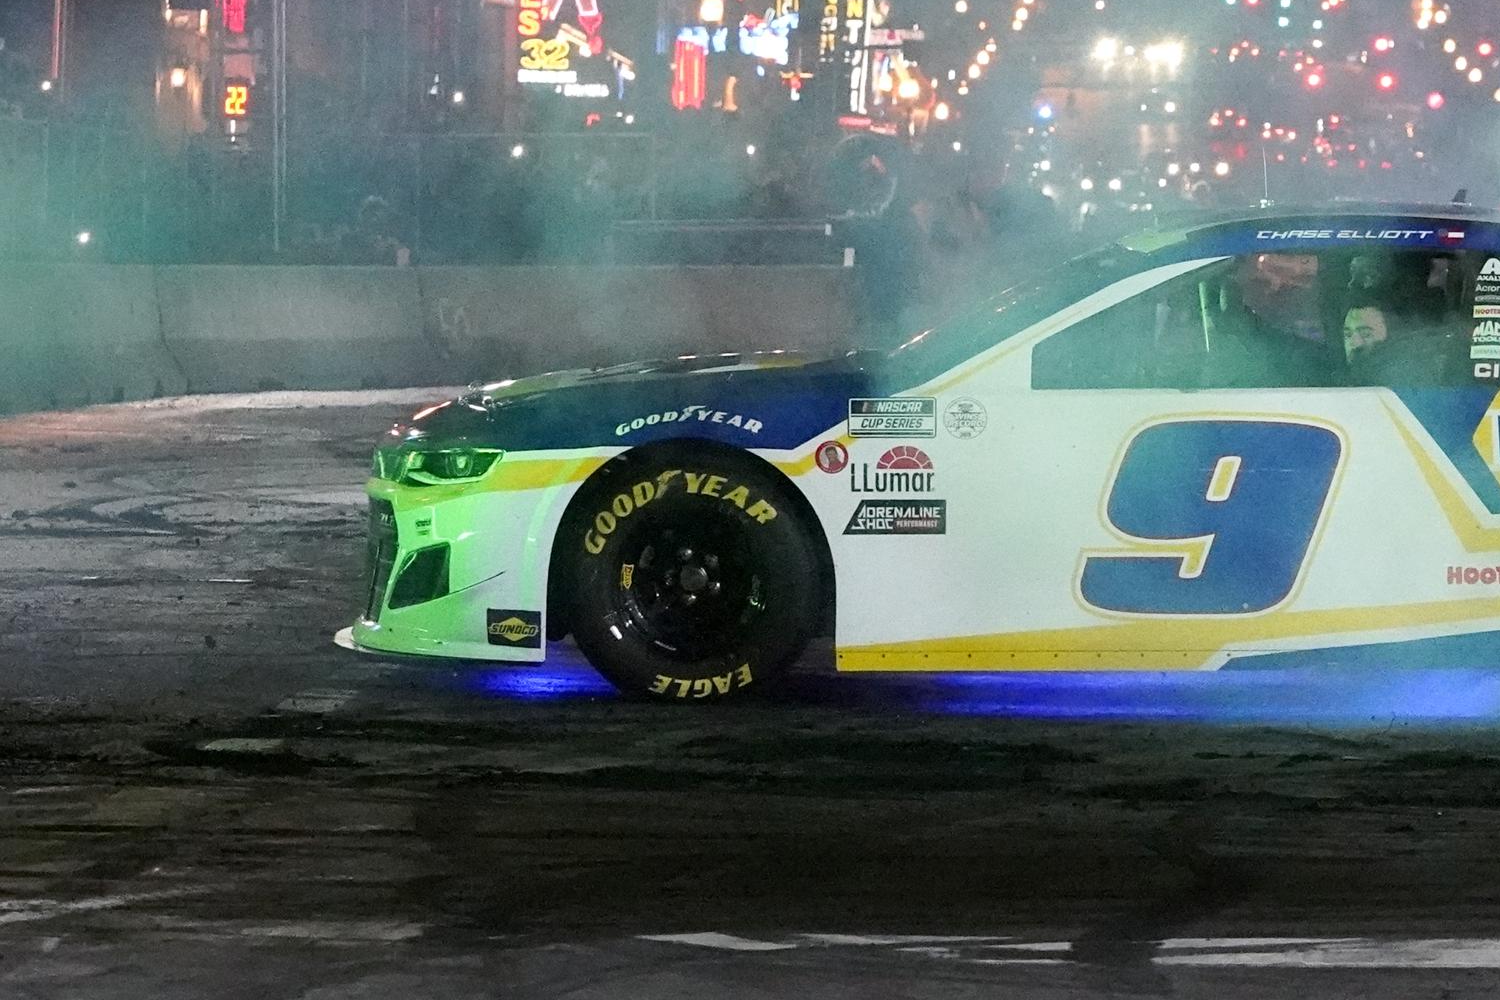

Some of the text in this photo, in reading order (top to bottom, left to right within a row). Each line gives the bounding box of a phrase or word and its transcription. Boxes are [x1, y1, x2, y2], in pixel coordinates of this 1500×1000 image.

[520, 38, 570, 70] 32
[1256, 229, 1434, 240] CHASE ELLIOTT
[876, 401, 923, 413] NASCAR
[861, 417, 924, 429] CUP SERIES
[857, 505, 941, 518] ADRENALINE
[1076, 416, 1346, 618] 9
[851, 518, 894, 530] SHOC
[491, 624, 537, 635] SUNOCO
[649, 664, 753, 698] EAGLE
